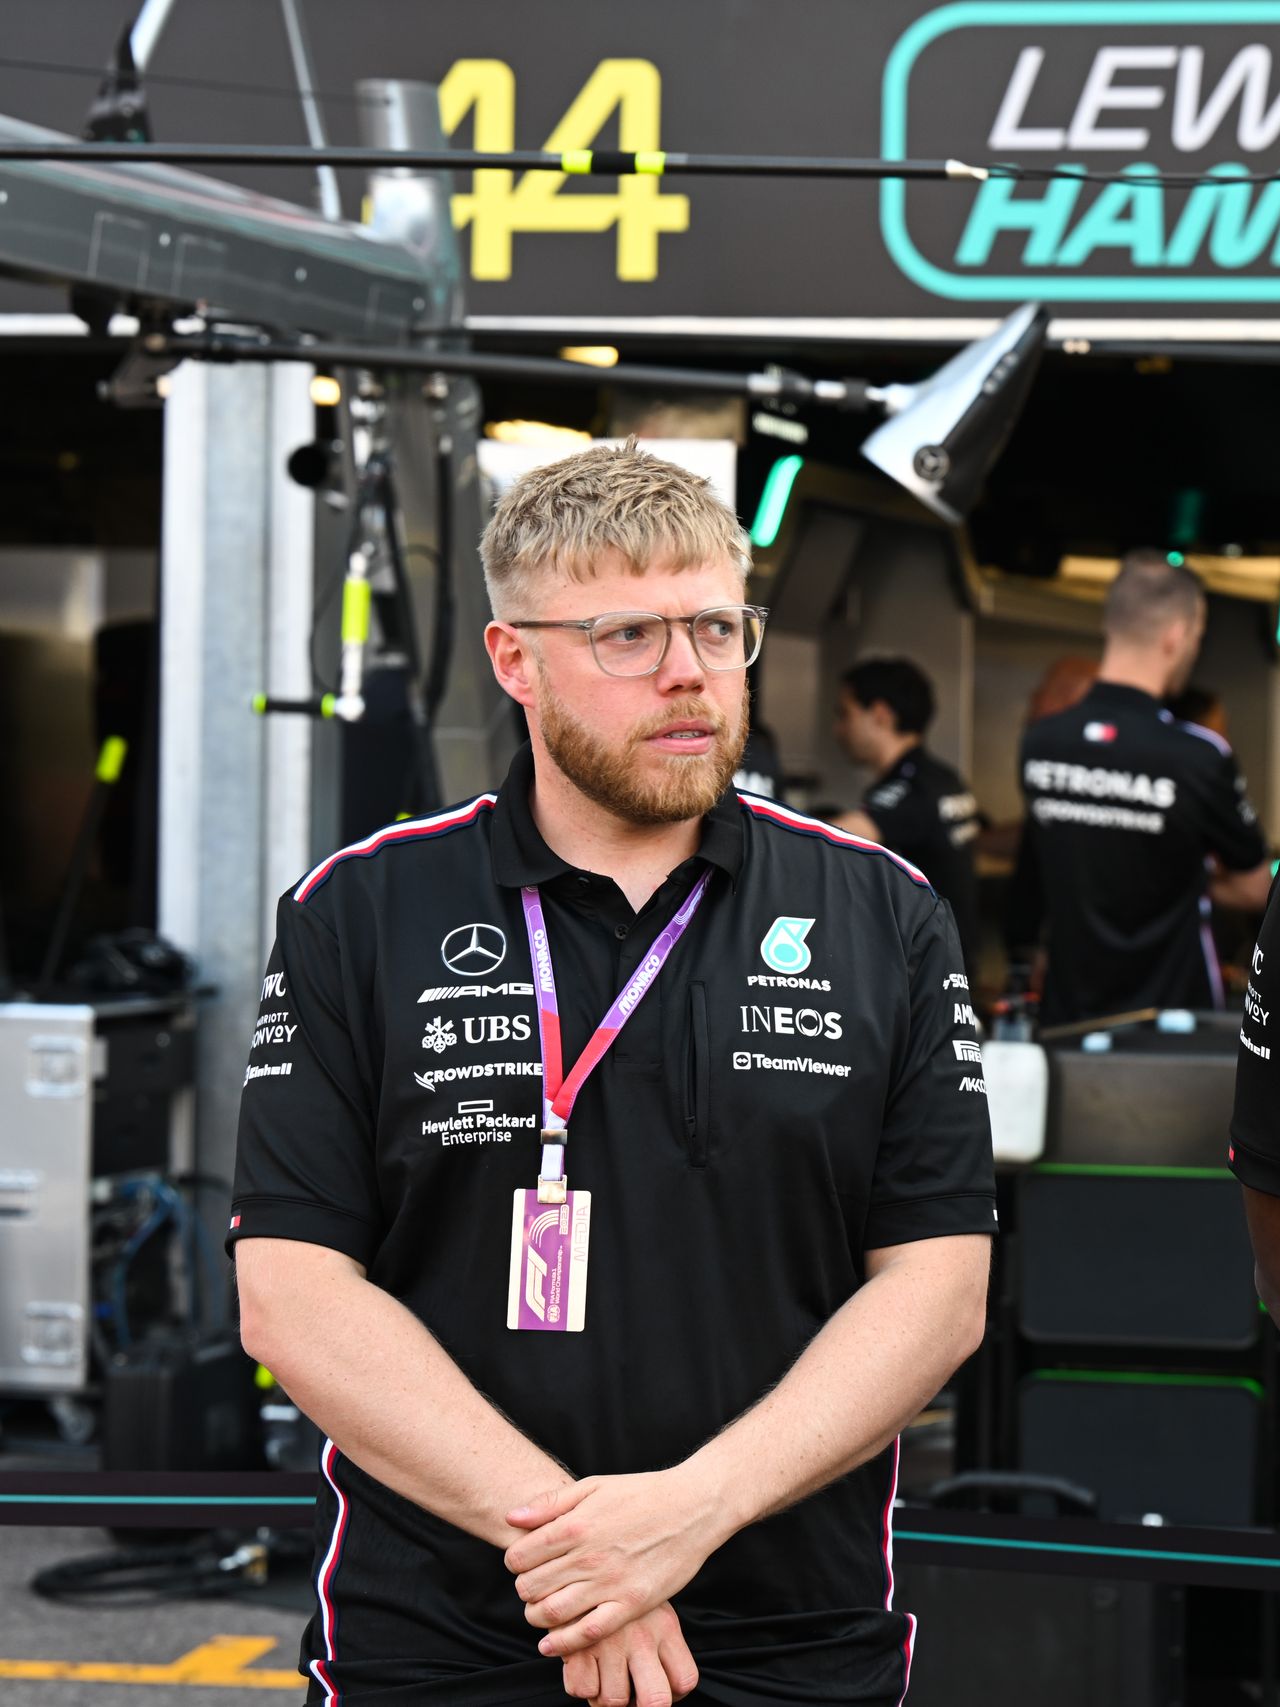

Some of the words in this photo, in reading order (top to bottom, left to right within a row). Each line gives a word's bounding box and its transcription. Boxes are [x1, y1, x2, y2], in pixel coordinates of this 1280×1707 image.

[533, 928, 554, 994] MONACO
[454, 982, 534, 999] AMG
[617, 953, 661, 1017] MONACO
[747, 974, 832, 992] PETRONAS
[461, 1014, 532, 1044] UBS
[740, 1005, 843, 1040] INEOS
[952, 1039, 982, 1064] PIRE
[422, 1062, 543, 1084] CROWDSTRIKE
[752, 1053, 852, 1077] TeamViewer
[422, 1115, 474, 1135] Hewlett
[476, 1113, 536, 1130] Packard
[441, 1128, 512, 1146] Enterprise
